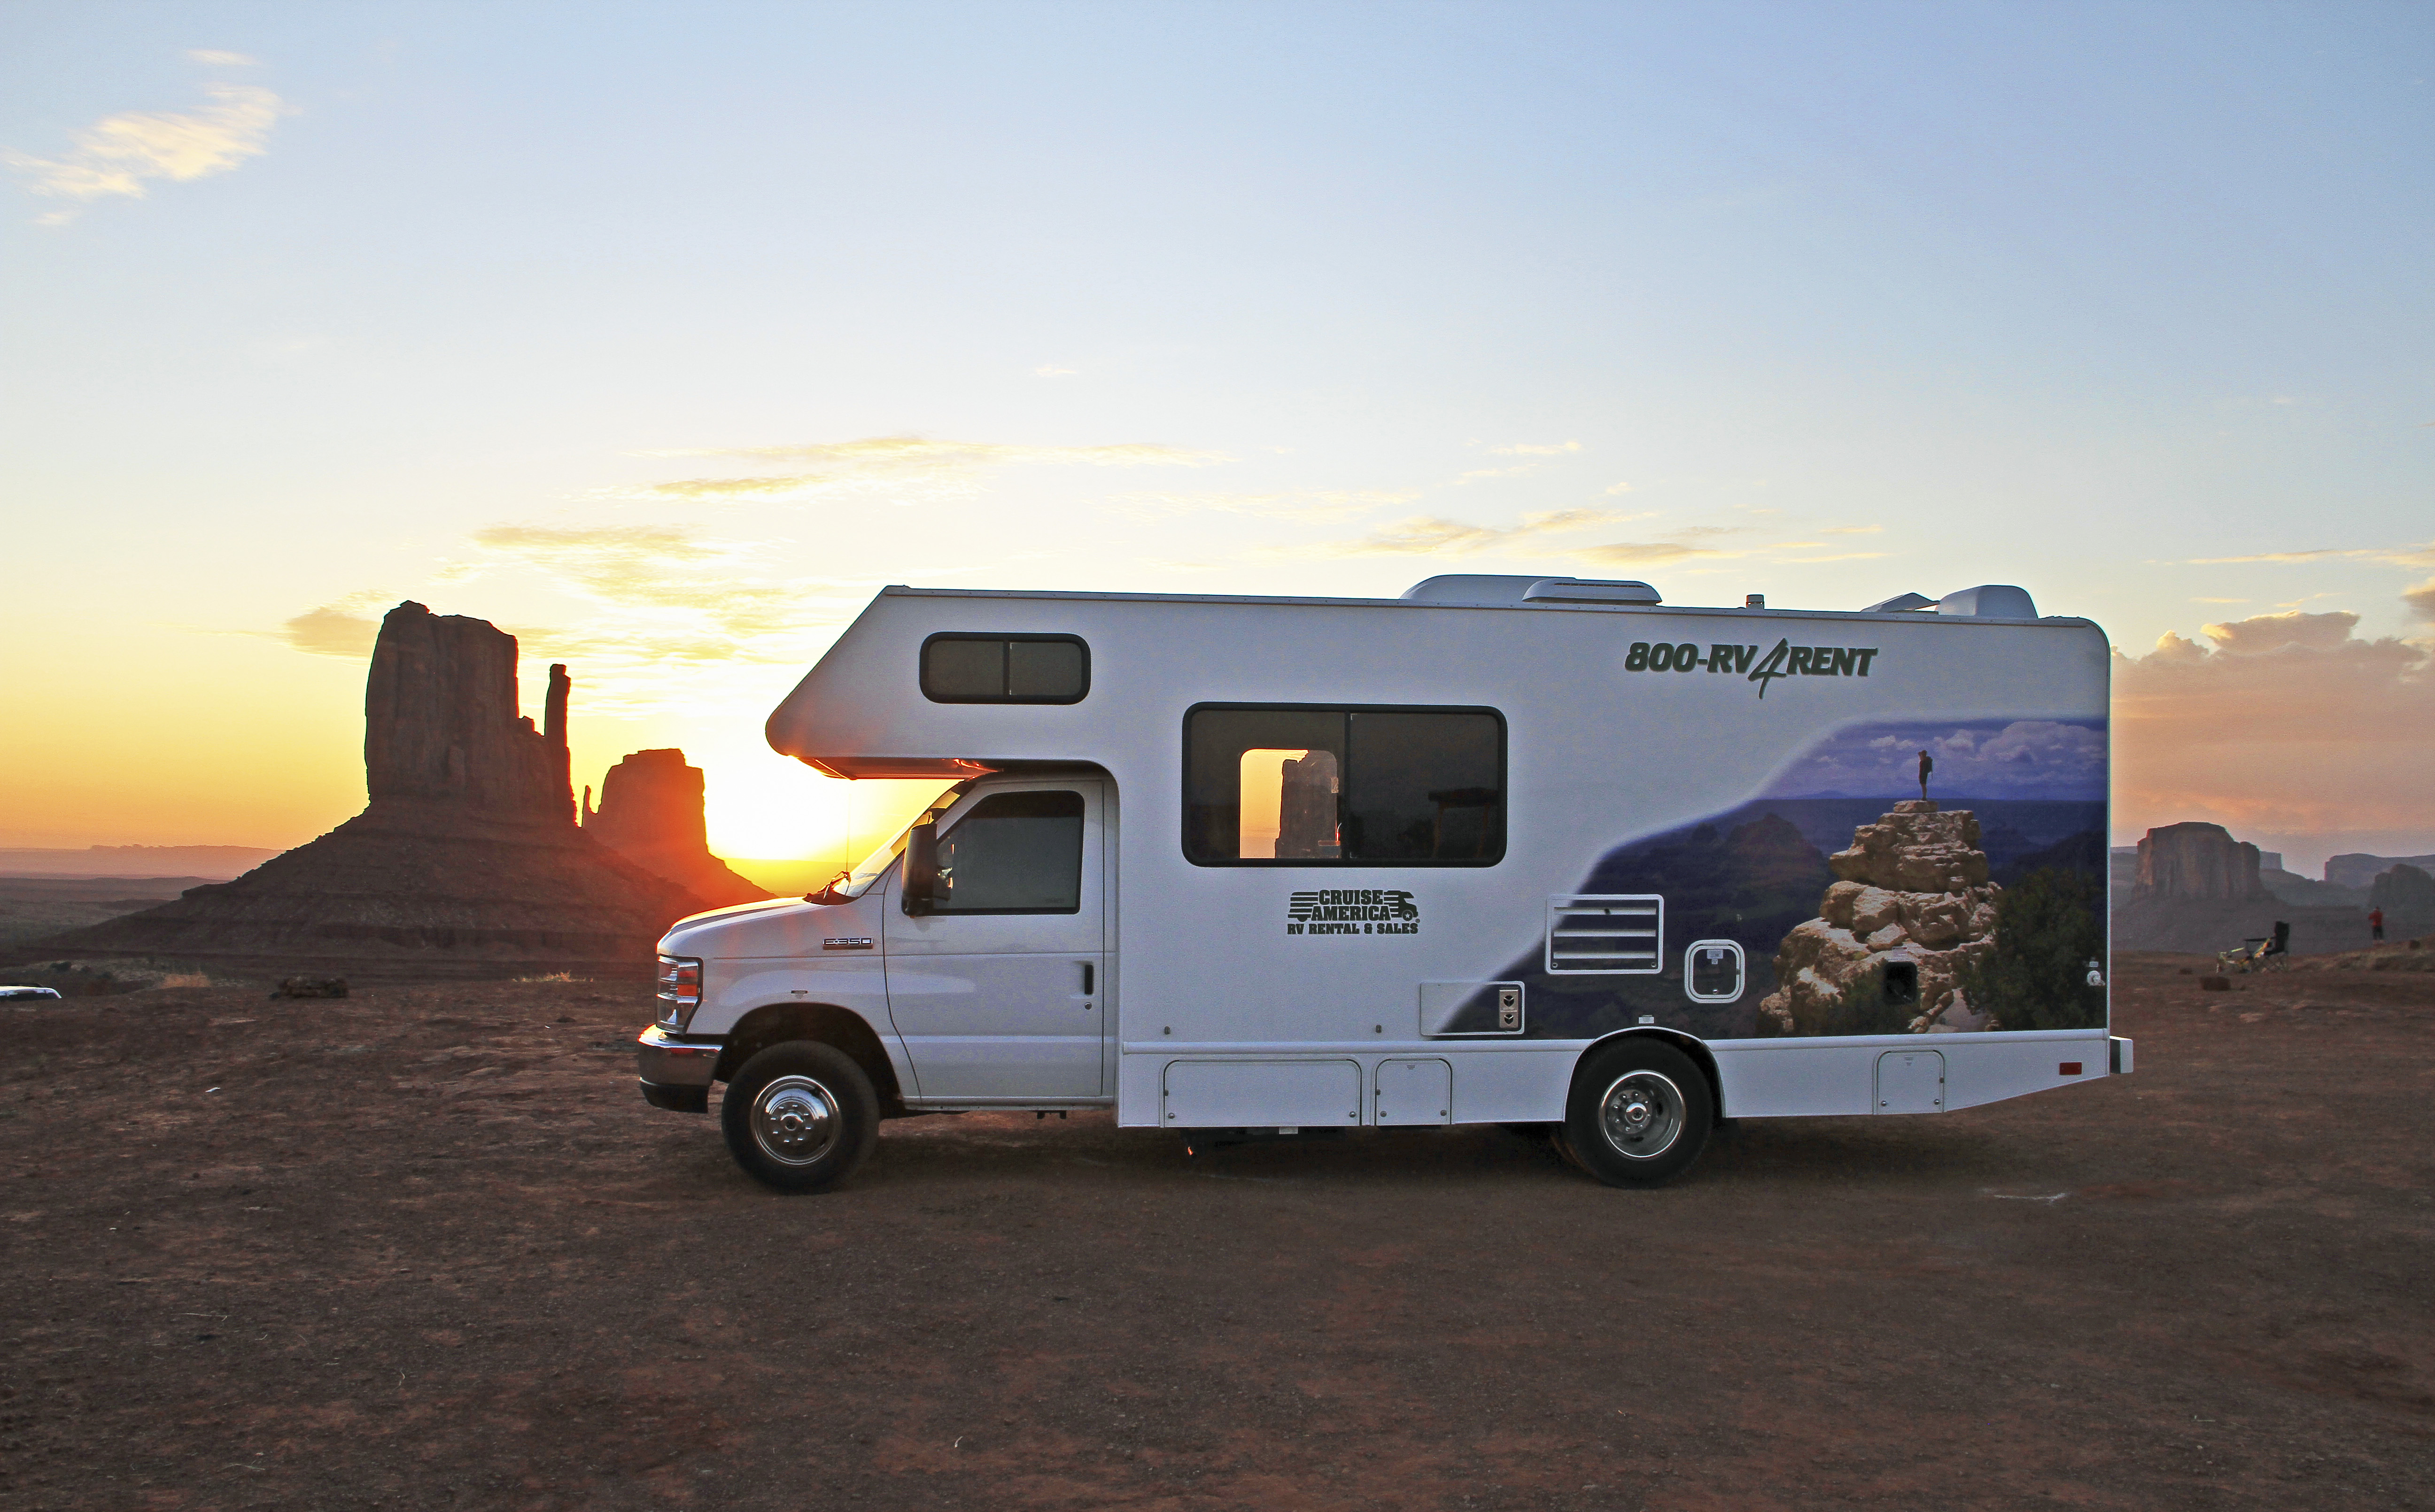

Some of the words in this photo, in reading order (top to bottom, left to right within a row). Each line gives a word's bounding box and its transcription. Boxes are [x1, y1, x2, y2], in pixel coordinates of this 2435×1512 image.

[1318, 889, 1384, 905] CRUISE
[1311, 905, 1391, 921] AMERICA
[1287, 923, 1305, 934] RV
[1308, 923, 1360, 934] RENTAL
[1364, 923, 1373, 934] &
[1376, 923, 1419, 934] SALES
